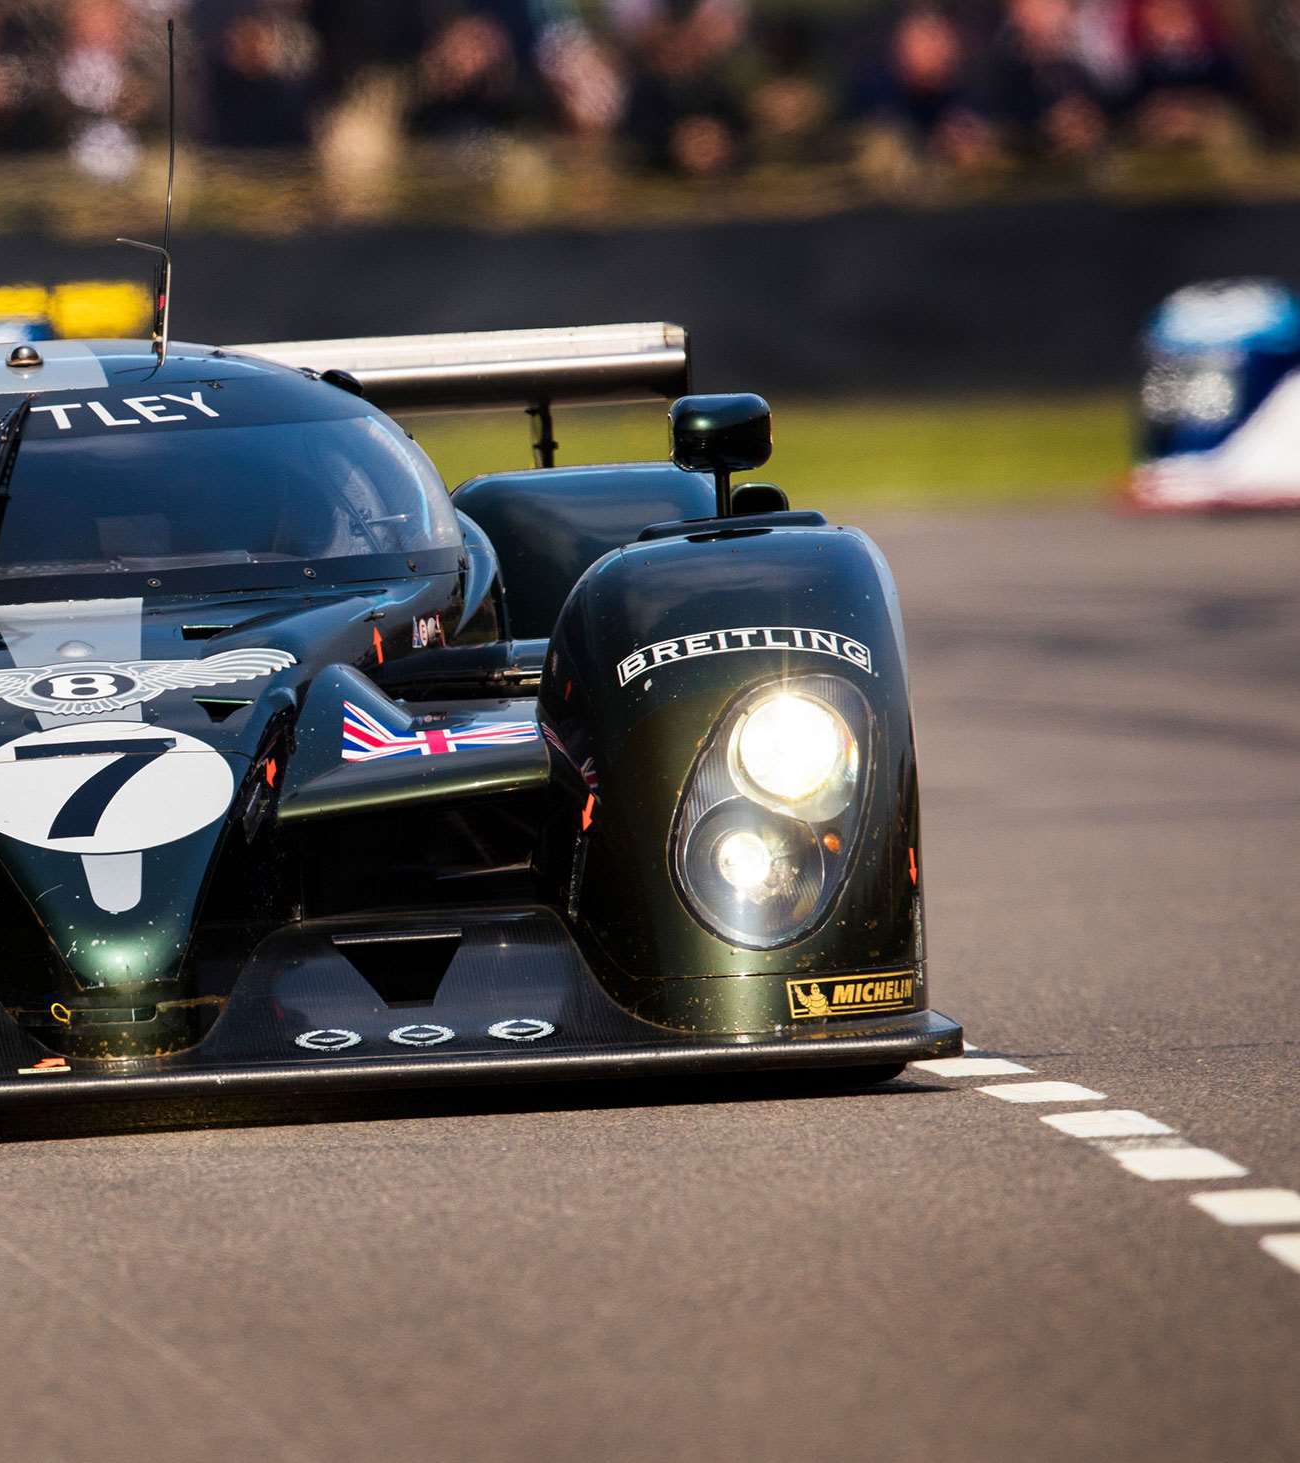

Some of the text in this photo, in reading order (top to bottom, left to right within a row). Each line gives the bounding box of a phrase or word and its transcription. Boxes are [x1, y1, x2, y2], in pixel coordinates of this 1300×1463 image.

[623, 629, 869, 681] BREITLING
[49, 673, 118, 699] B
[14, 737, 177, 840] 7
[832, 978, 913, 1004] MICHELIN
